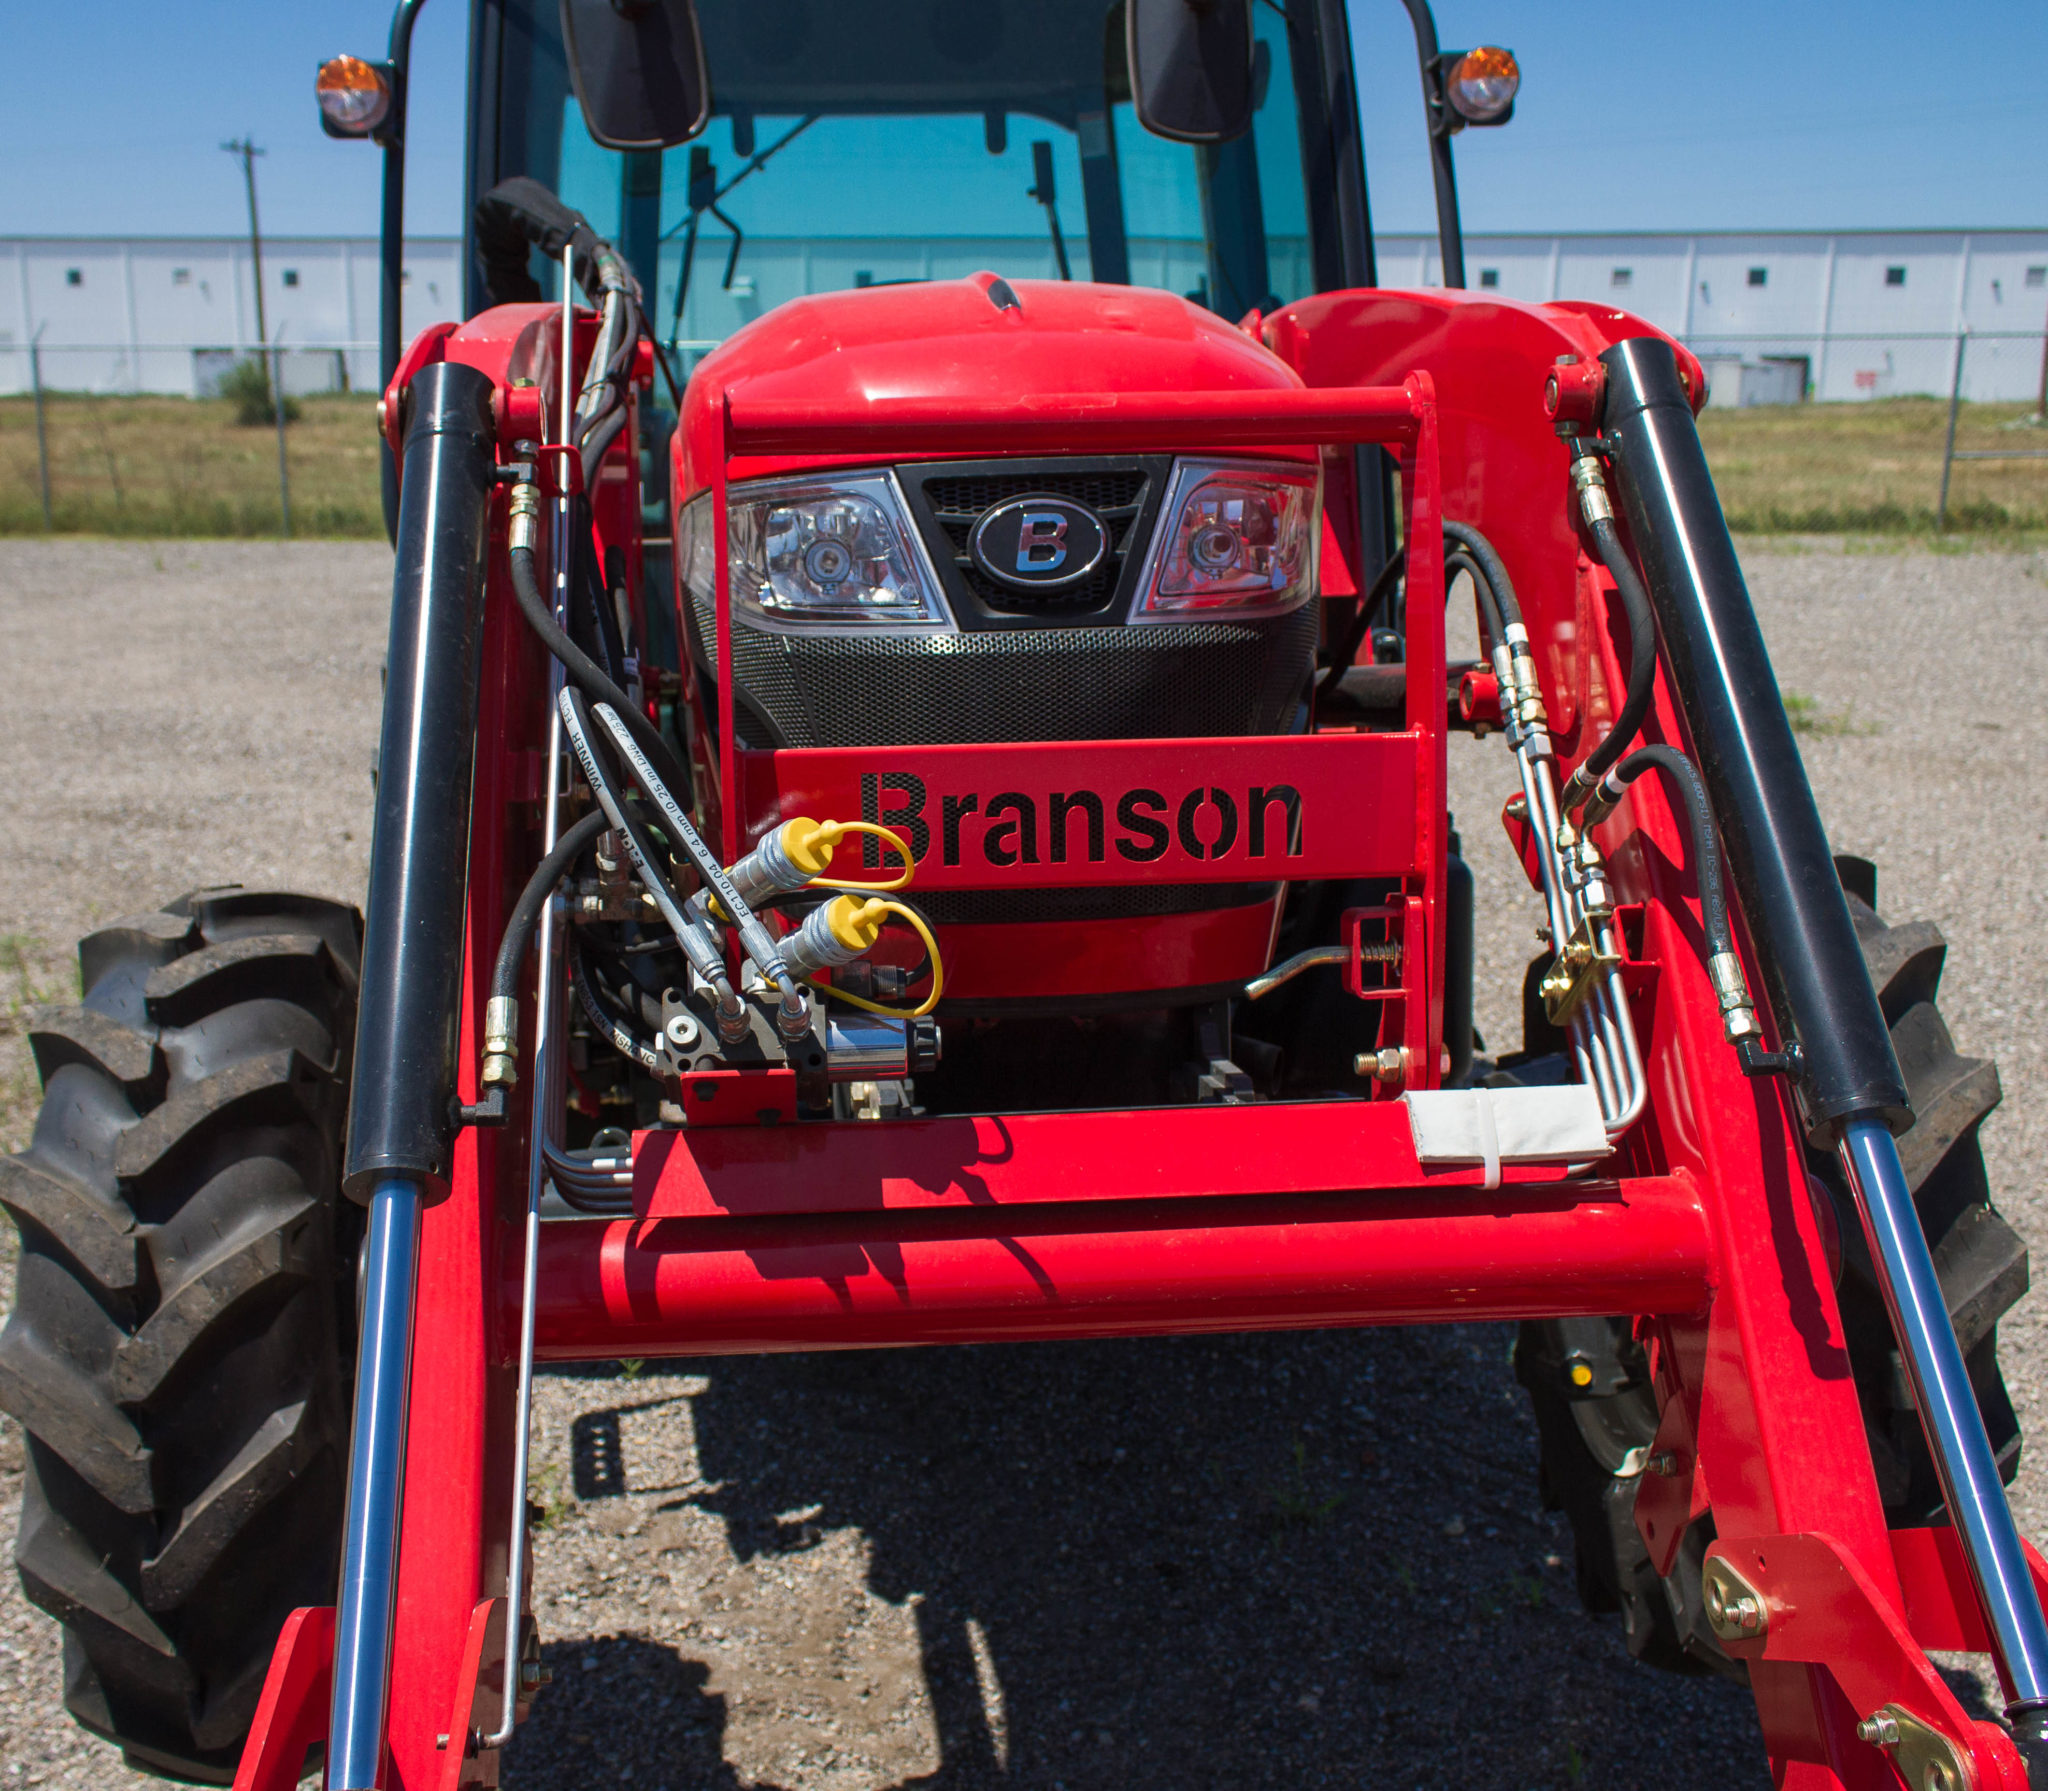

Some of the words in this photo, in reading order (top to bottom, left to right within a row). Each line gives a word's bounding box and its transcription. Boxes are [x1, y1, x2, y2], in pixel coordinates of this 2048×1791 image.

[1015, 512, 1067, 572] B
[572, 732, 602, 791] WINNER
[627, 743, 646, 767] DN6
[643, 768, 657, 783] in)
[653, 783, 678, 813] (0.25
[677, 815, 694, 836] mm
[860, 772, 1304, 870] Branson
[691, 838, 708, 858] 6.4
[709, 864, 750, 918] EC110-04
